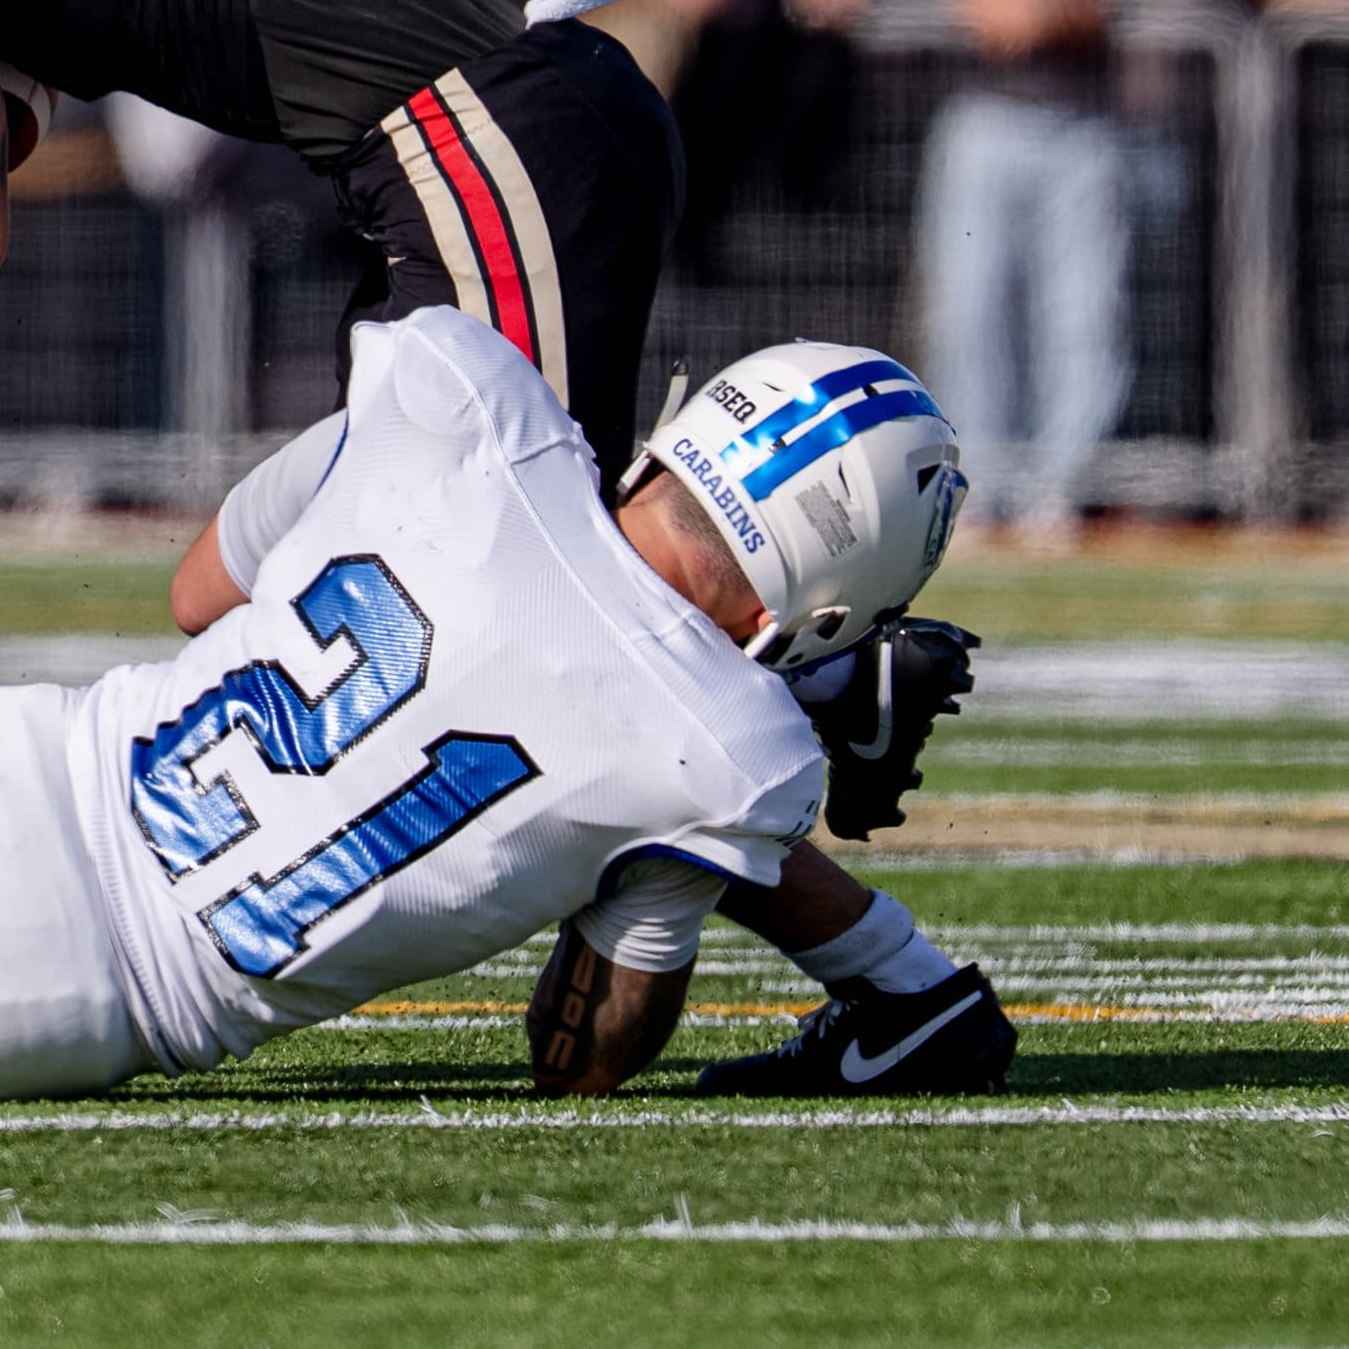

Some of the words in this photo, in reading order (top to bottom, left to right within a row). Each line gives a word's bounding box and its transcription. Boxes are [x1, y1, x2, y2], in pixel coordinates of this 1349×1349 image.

[706, 378, 758, 425] RSEQ
[672, 437, 766, 554] CARABINS
[131, 553, 545, 980] 21
